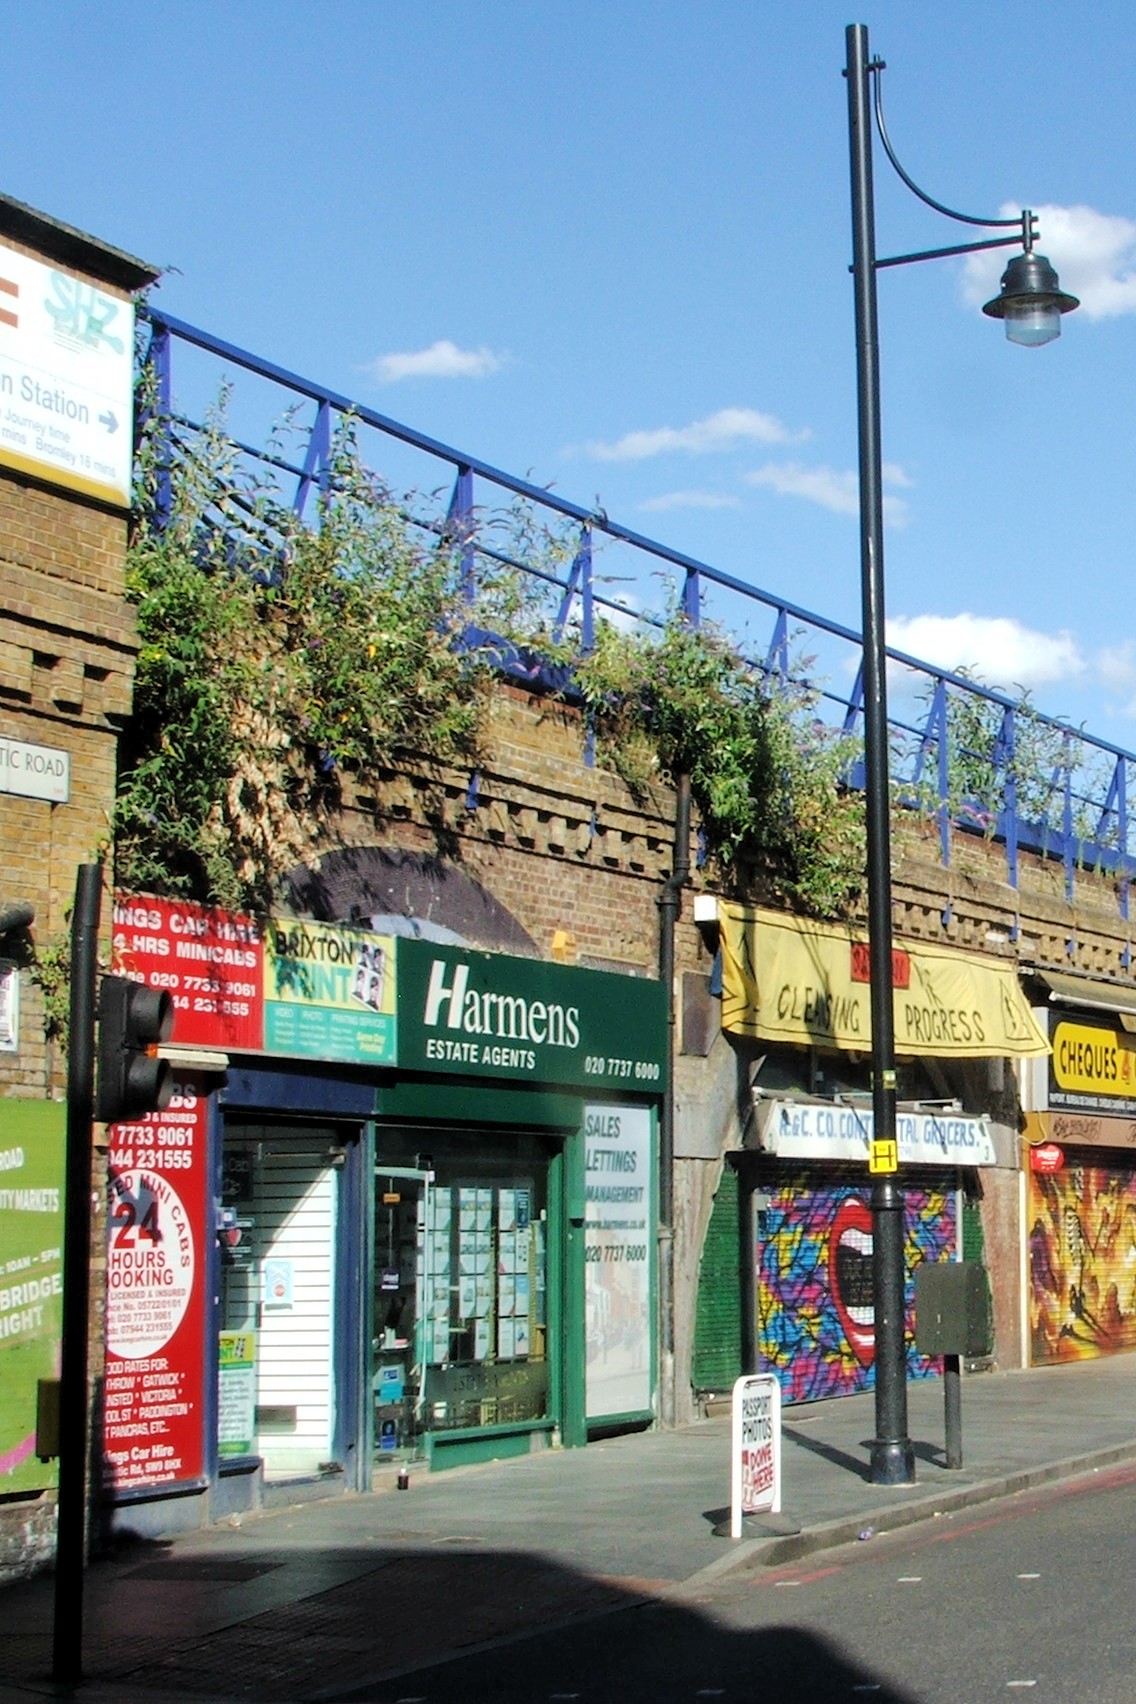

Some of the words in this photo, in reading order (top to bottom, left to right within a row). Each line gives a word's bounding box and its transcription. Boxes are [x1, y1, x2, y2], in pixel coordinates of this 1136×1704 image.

[20, 375, 90, 425] Station
[4, 408, 46, 437] Journey
[1, 427, 28, 445] mins
[35, 436, 77, 466] Bromley
[93, 461, 117, 479] mins
[25, 752, 65, 777] ROAD
[132, 934, 170, 957] HRS
[176, 941, 257, 968] MINICABS
[275, 930, 354, 966] BRIXTON
[150, 971, 180, 989] 020
[424, 960, 580, 1049] Harmens
[905, 1003, 986, 1042] PROGRESS
[426, 1038, 479, 1063] ESTATE
[482, 1045, 536, 1070] AGENTS
[1059, 1040, 1117, 1080] CHEQUES
[585, 1055, 605, 1075] 020
[608, 1058, 632, 1077] 7737
[635, 1061, 660, 1081] 6000
[117, 1125, 154, 1145] 7733
[157, 1127, 194, 1146] 9061
[585, 1114, 622, 1139] SALES
[135, 1149, 193, 1169] 231555
[585, 1148, 637, 1173] LETTINGS
[14, 1188, 59, 1213] MARKETS
[586, 1186, 645, 1204] MANAGEMENT
[113, 1201, 163, 1250] 24
[171, 1206, 191, 1268] CABS
[111, 1250, 166, 1270] HOURS
[604, 1245, 624, 1263] 7737
[626, 1244, 647, 1262] 6000
[0, 1272, 63, 1312] BRIDGE
[742, 1417, 772, 1443] PHOTOS
[131, 1446, 151, 1461] Car
[151, 1443, 174, 1459] Hire
[750, 1442, 772, 1470] DONE
[753, 1465, 774, 1491] HERE
